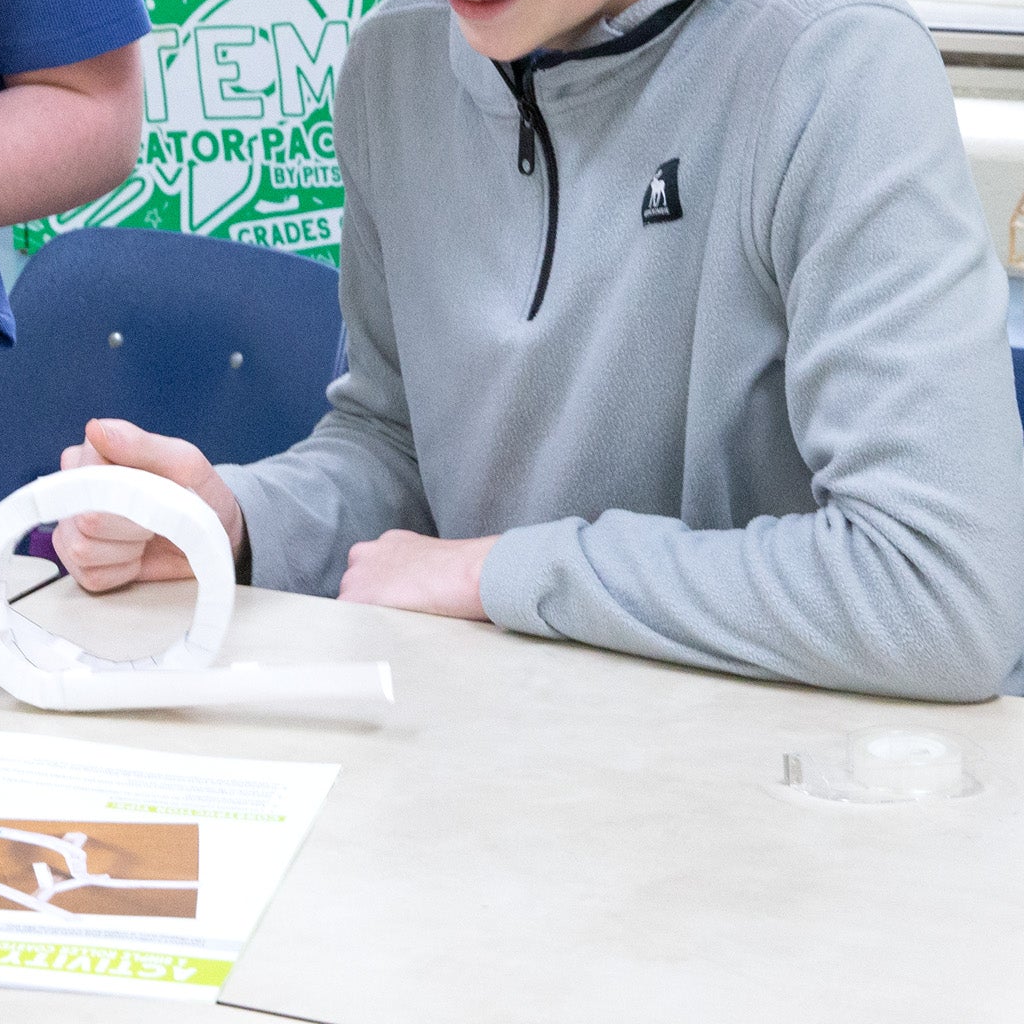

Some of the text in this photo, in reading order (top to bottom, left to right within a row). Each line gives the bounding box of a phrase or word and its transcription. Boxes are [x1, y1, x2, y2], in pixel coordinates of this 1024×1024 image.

[141, 21, 349, 123] TEM
[138, 126, 336, 164] ATOR PAC
[274, 166, 342, 184] BY PITS
[238, 217, 331, 248] GRADES
